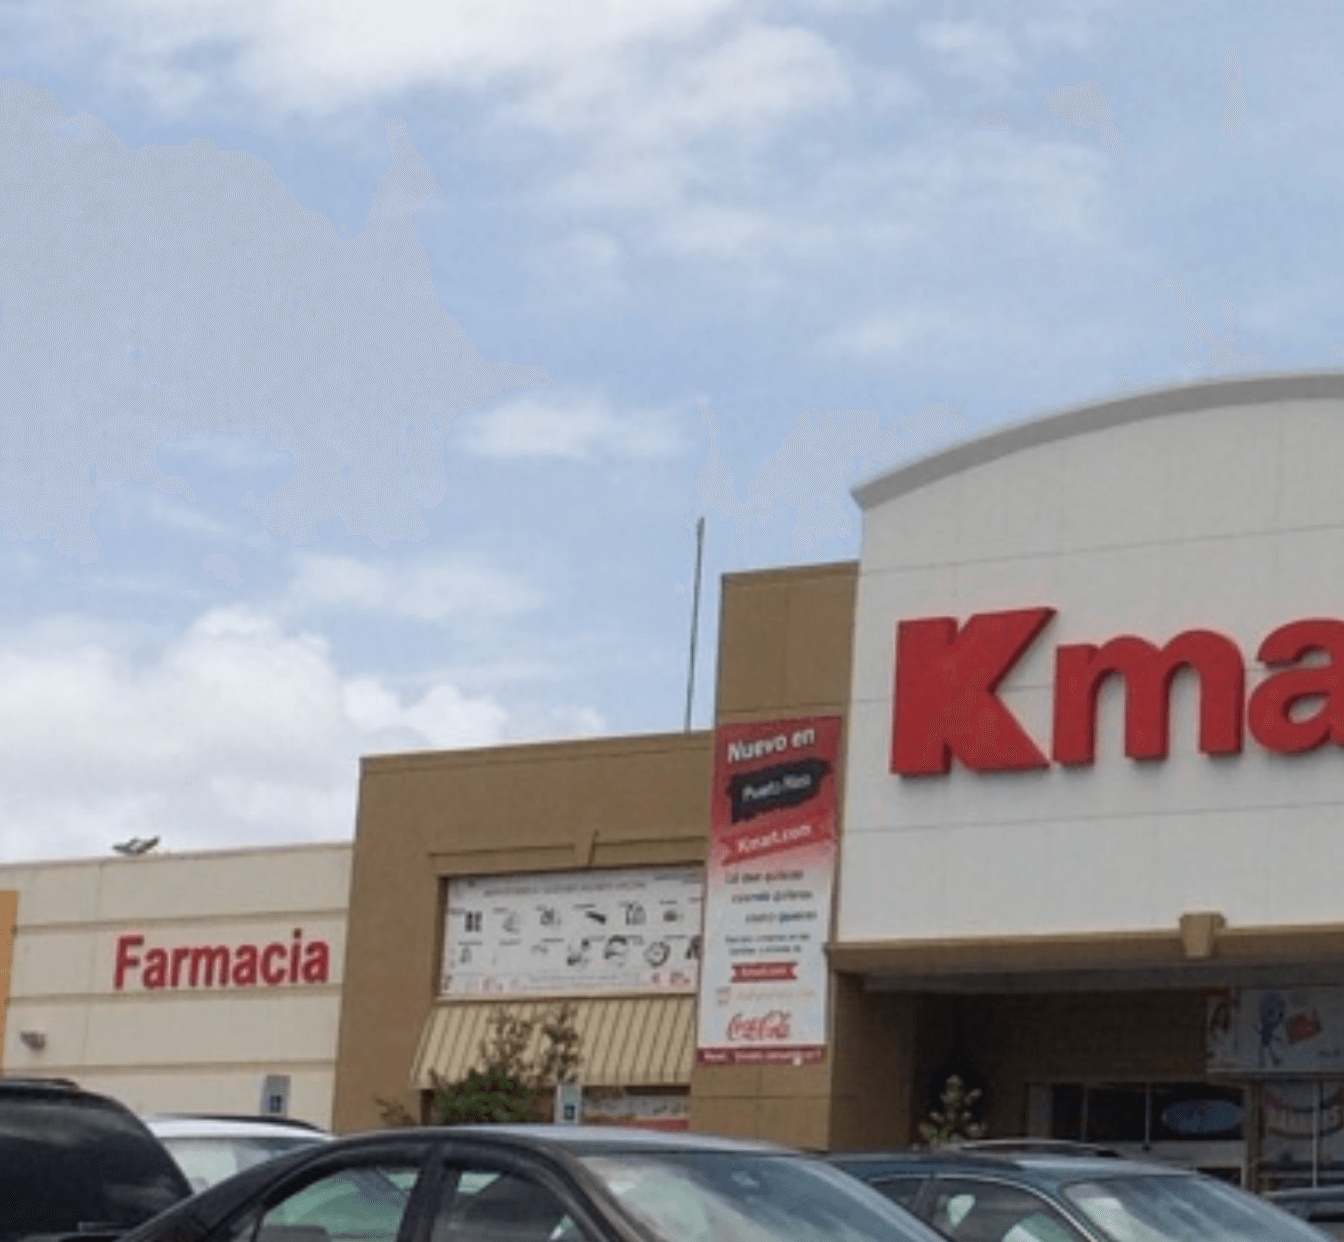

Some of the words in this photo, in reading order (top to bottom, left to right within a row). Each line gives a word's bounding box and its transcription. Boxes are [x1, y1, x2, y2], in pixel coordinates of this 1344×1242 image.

[727, 734, 787, 763] Nuevo
[791, 728, 815, 748] en
[113, 927, 329, 991] Farmacia
